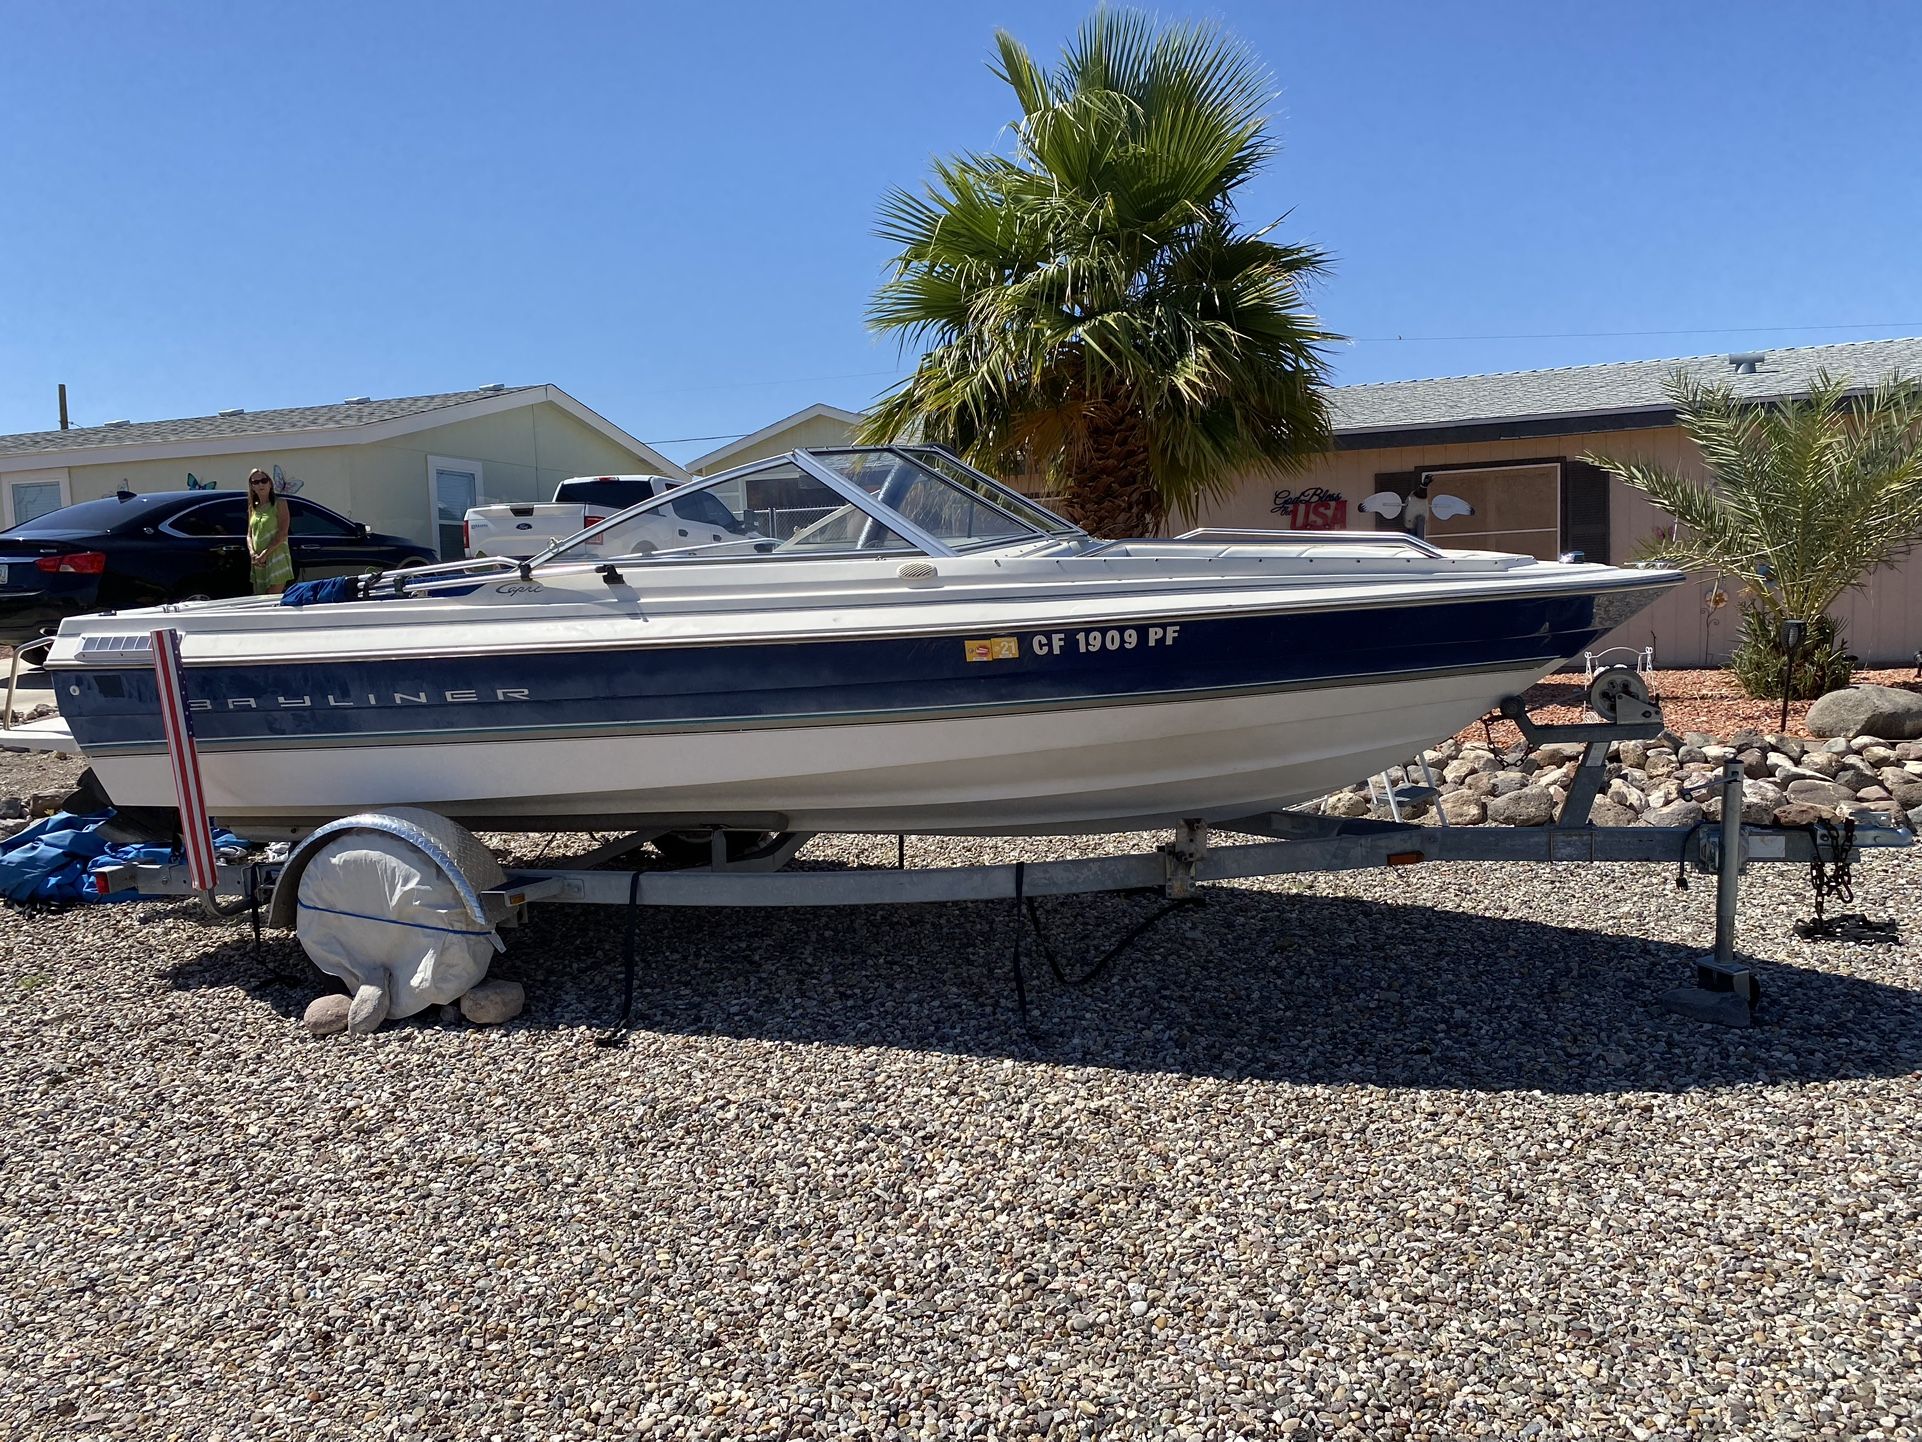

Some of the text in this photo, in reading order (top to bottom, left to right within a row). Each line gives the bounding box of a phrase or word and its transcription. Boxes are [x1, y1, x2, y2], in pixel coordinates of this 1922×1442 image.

[1274, 490, 1303, 506] God
[1290, 500, 1347, 530] USA
[496, 583, 544, 596] Capri
[1032, 626, 1180, 655] CF 1909 PF
